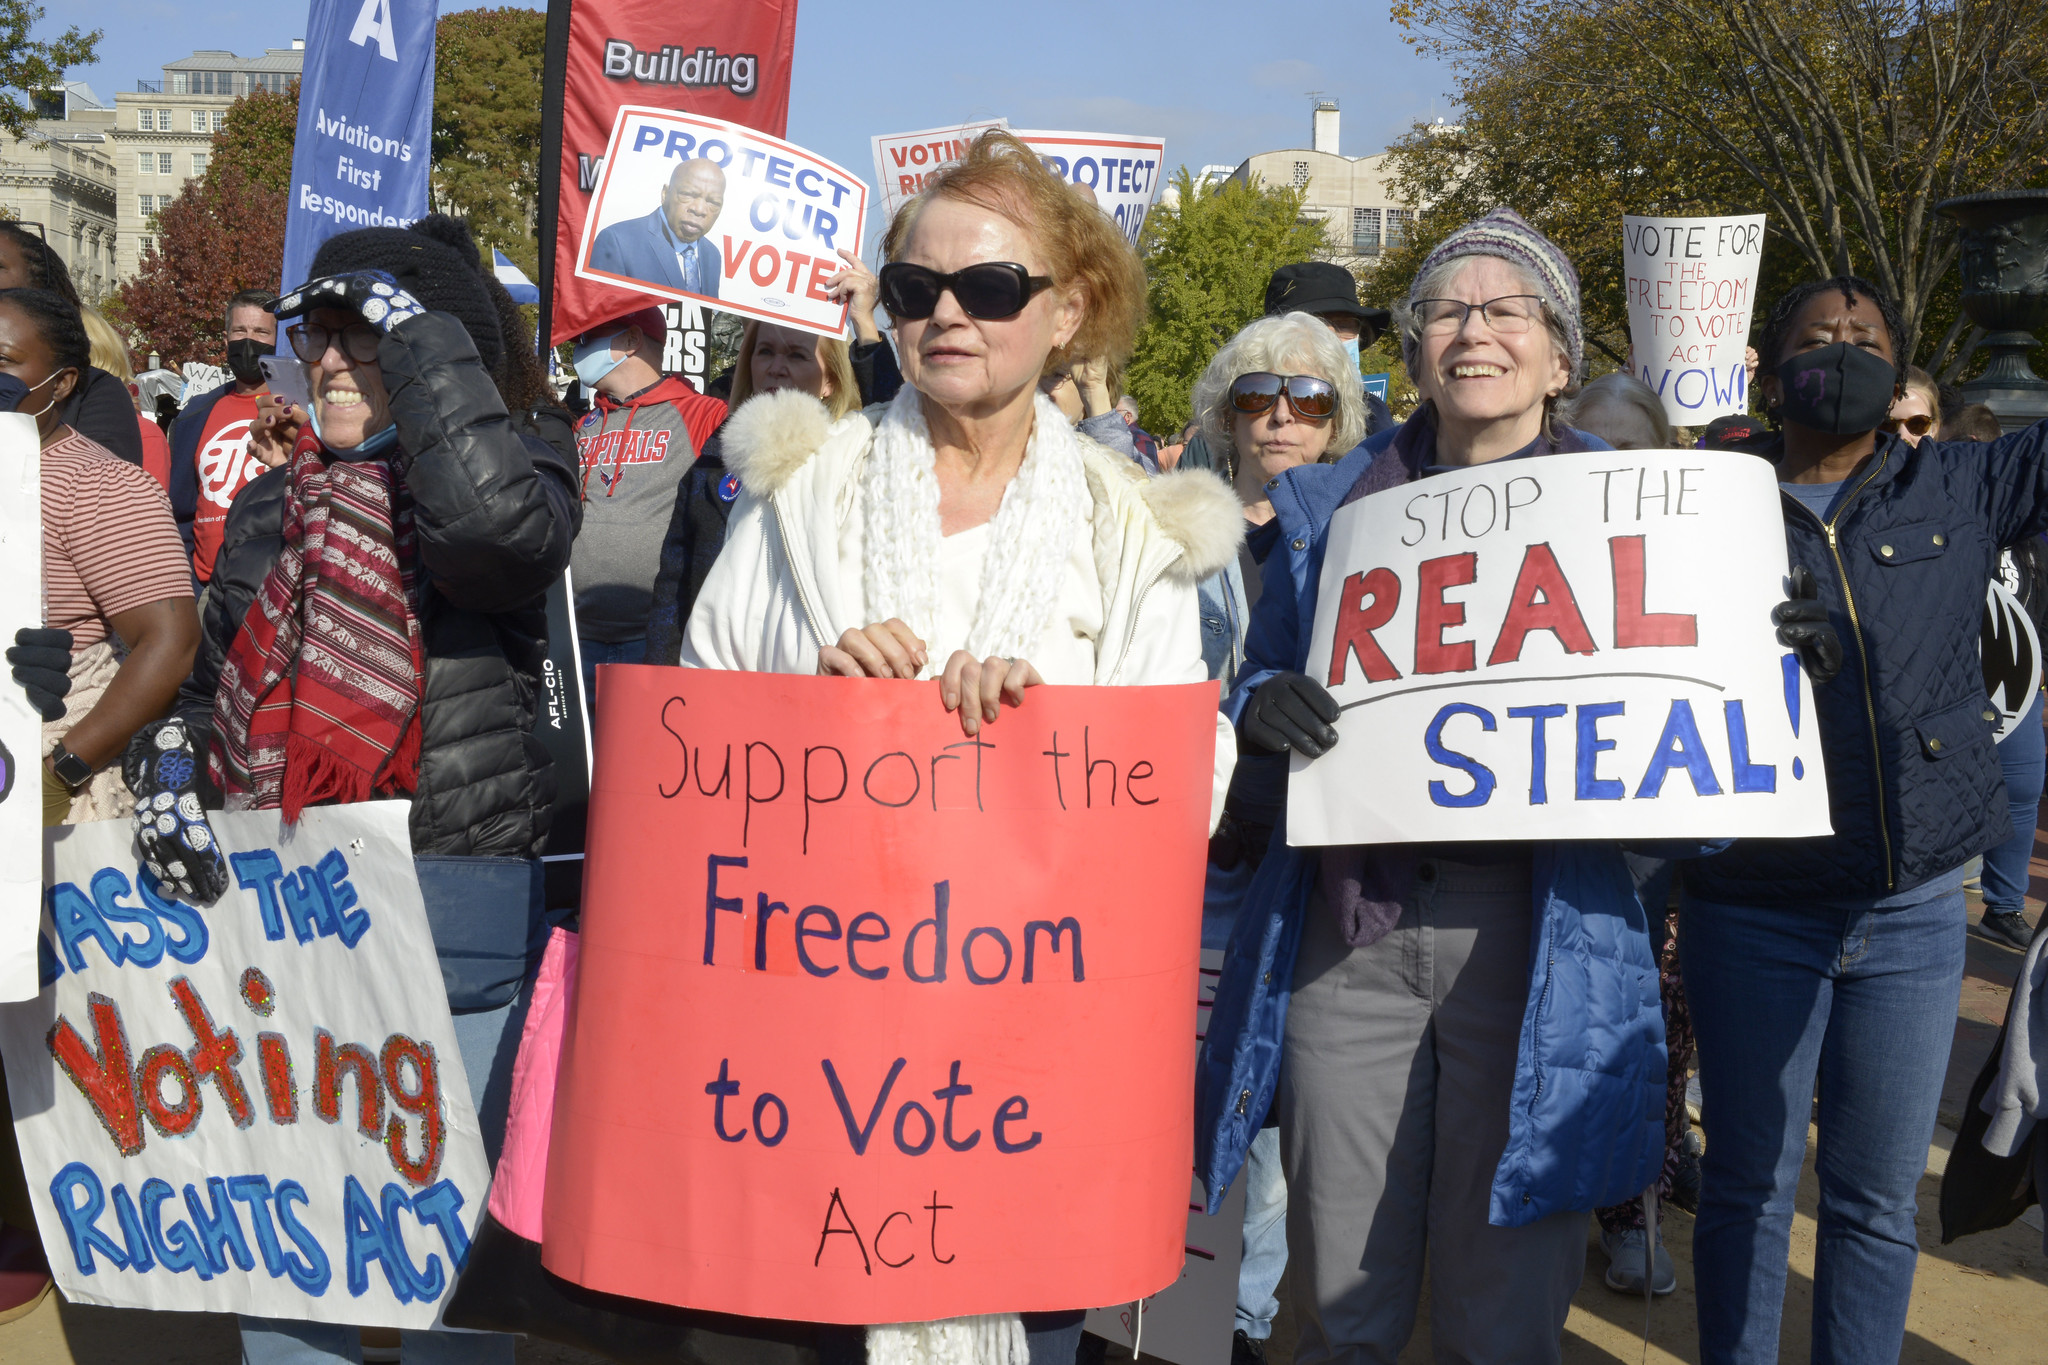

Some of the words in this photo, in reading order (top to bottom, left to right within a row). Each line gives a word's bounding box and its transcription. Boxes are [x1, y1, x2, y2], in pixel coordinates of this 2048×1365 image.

[603, 40, 757, 93] Building
[315, 107, 412, 162] Aviation's
[632, 124, 850, 209] PROTECT
[890, 138, 971, 168] VOTIN
[337, 155, 382, 191] First
[749, 191, 839, 250] OUR
[1625, 224, 1706, 258] VOTE
[1717, 223, 1760, 257] FOR
[722, 234, 844, 303] VOTE
[1628, 276, 1748, 311] FREEDOM
[1664, 262, 1707, 280] THE
[1650, 314, 1685, 337] TO
[1695, 312, 1746, 338] VOTE
[1668, 344, 1718, 363] ACT
[1642, 363, 1746, 410] NOW!
[576, 429, 671, 467] CAPITALS
[1401, 476, 1542, 546] STOP
[1588, 467, 1704, 523] THE
[1326, 534, 1698, 688] REAL
[542, 659, 562, 729] AFL-CIO
[1424, 653, 1804, 808] STEAL!
[659, 696, 996, 855] Support
[1043, 725, 1159, 811] the
[41, 866, 209, 986] ASS
[229, 847, 371, 950] THE
[703, 854, 1085, 985] Freedom
[46, 966, 448, 1188] Voting
[705, 1058, 789, 1147] to
[821, 1057, 1042, 1156] Vote
[49, 1161, 331, 1297] RIGHTS
[343, 1174, 472, 1305] ACT
[814, 1186, 956, 1275] Act
